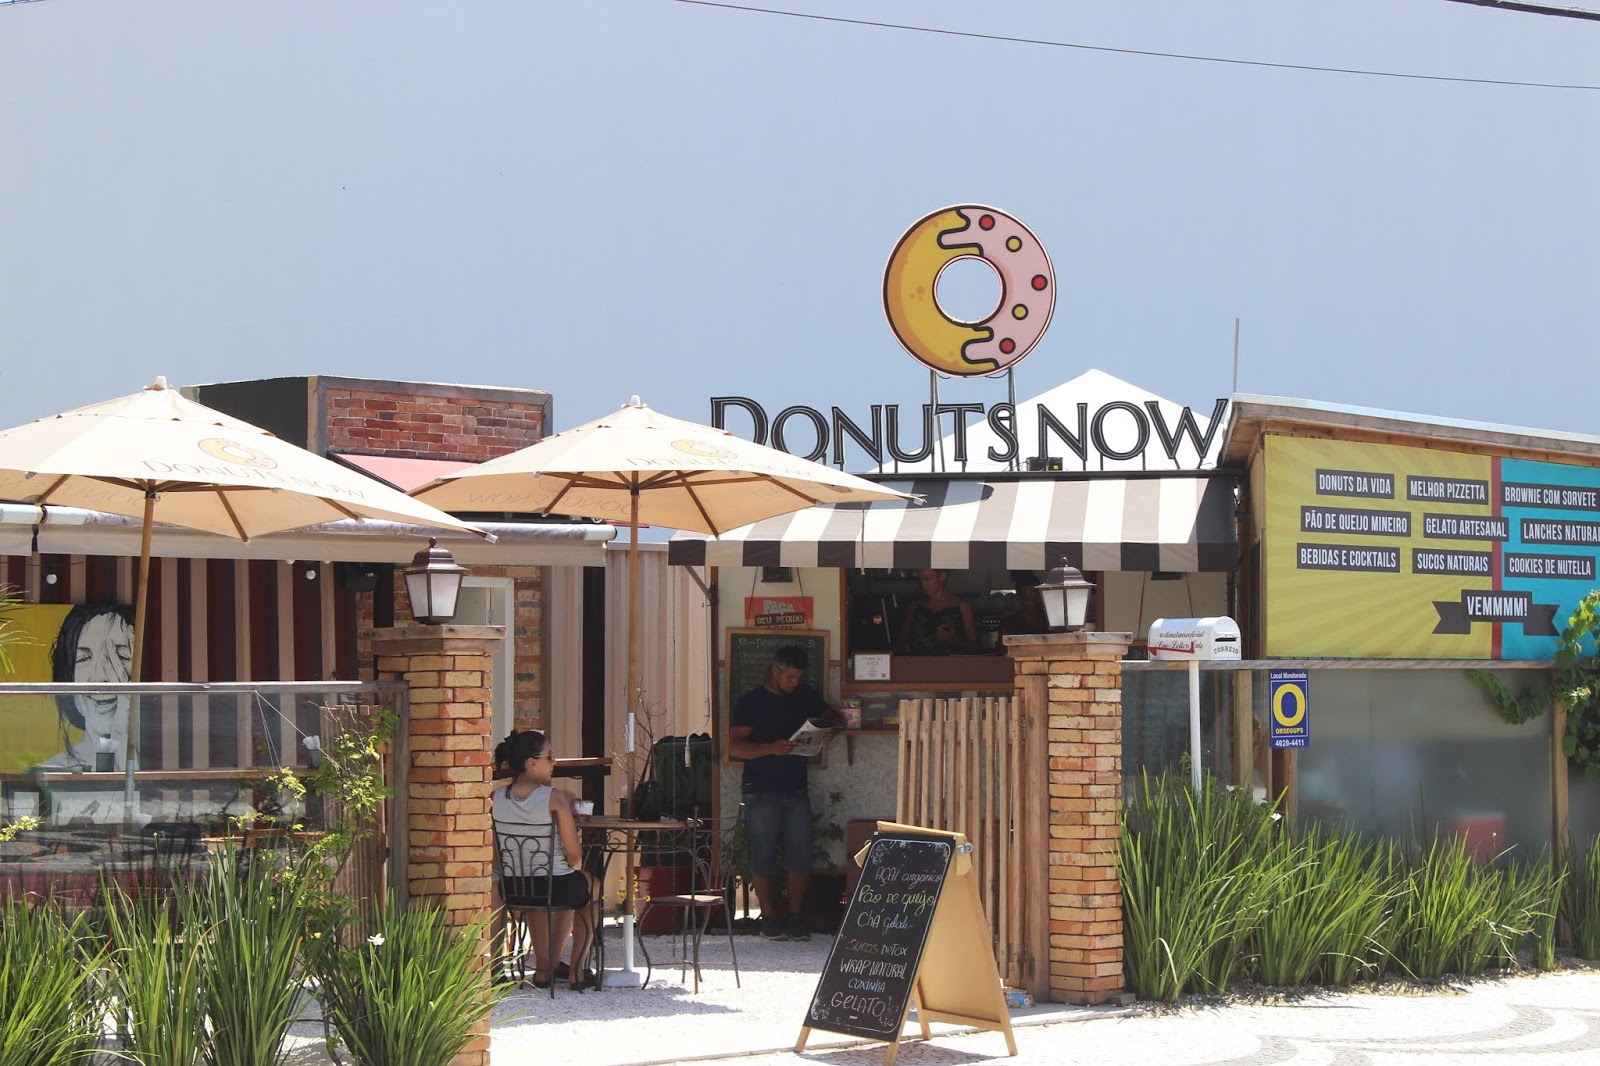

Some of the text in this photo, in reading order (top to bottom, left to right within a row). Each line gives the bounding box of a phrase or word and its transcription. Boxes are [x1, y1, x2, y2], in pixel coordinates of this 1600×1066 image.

[710, 396, 1228, 464] DONUTS NOW
[142, 460, 285, 483] DONUTS
[1319, 474, 1392, 495] DONUTS DA VIDA
[1410, 480, 1486, 501] MELHOR PIZZETTA
[1504, 486, 1597, 507] BROWNIE COM SORVETE
[1305, 511, 1408, 533] PÃO DE QUEIJO MINEIRO
[1426, 517, 1507, 538] GELATO ARTESANAL
[1523, 523, 1562, 541] LANCHES
[1300, 548, 1397, 568] BEBIDAS E COCKTAILS
[1417, 554, 1489, 572] SUCOS NATURAIS
[1509, 557, 1592, 576] COOKIES DE NUTELLA
[1466, 596, 1528, 617] VEMMMM!
[756, 615, 804, 625] SEU PEDIDO
[1213, 645, 1239, 655] CORREIO
[1275, 727, 1304, 735] ORSEGUPS
[1275, 739, 1305, 747] 4020-4411
[858, 884, 882, 904] Pão
[840, 957, 908, 980] WRAP NATURAL
